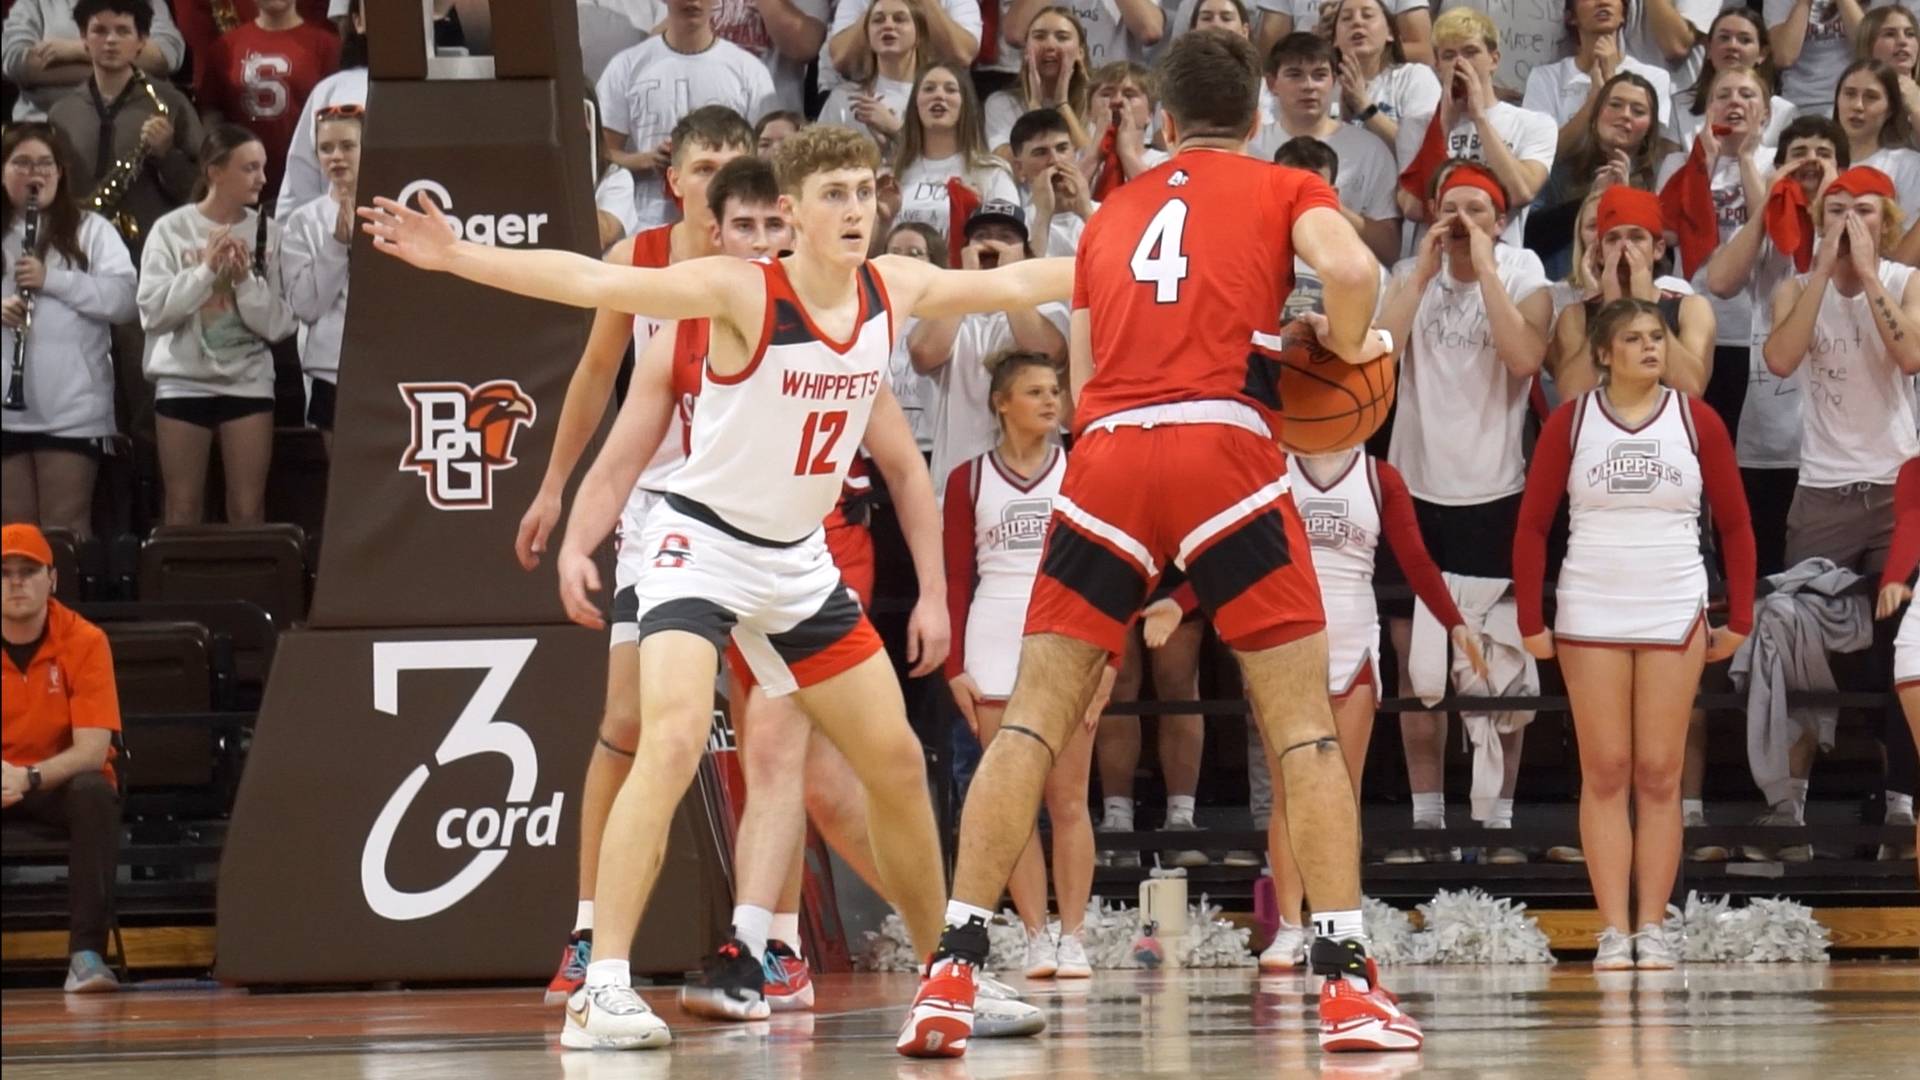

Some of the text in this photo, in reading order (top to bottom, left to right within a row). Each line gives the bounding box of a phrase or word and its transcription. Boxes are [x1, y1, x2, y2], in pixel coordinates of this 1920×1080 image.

[241, 53, 292, 117] S
[1129, 197, 1189, 304] 4
[782, 368, 880, 400] WHIPPETS
[794, 410, 849, 477] 12
[1586, 456, 1683, 488] WHIPPETS
[361, 638, 539, 921] 3
[436, 791, 565, 849] cord
